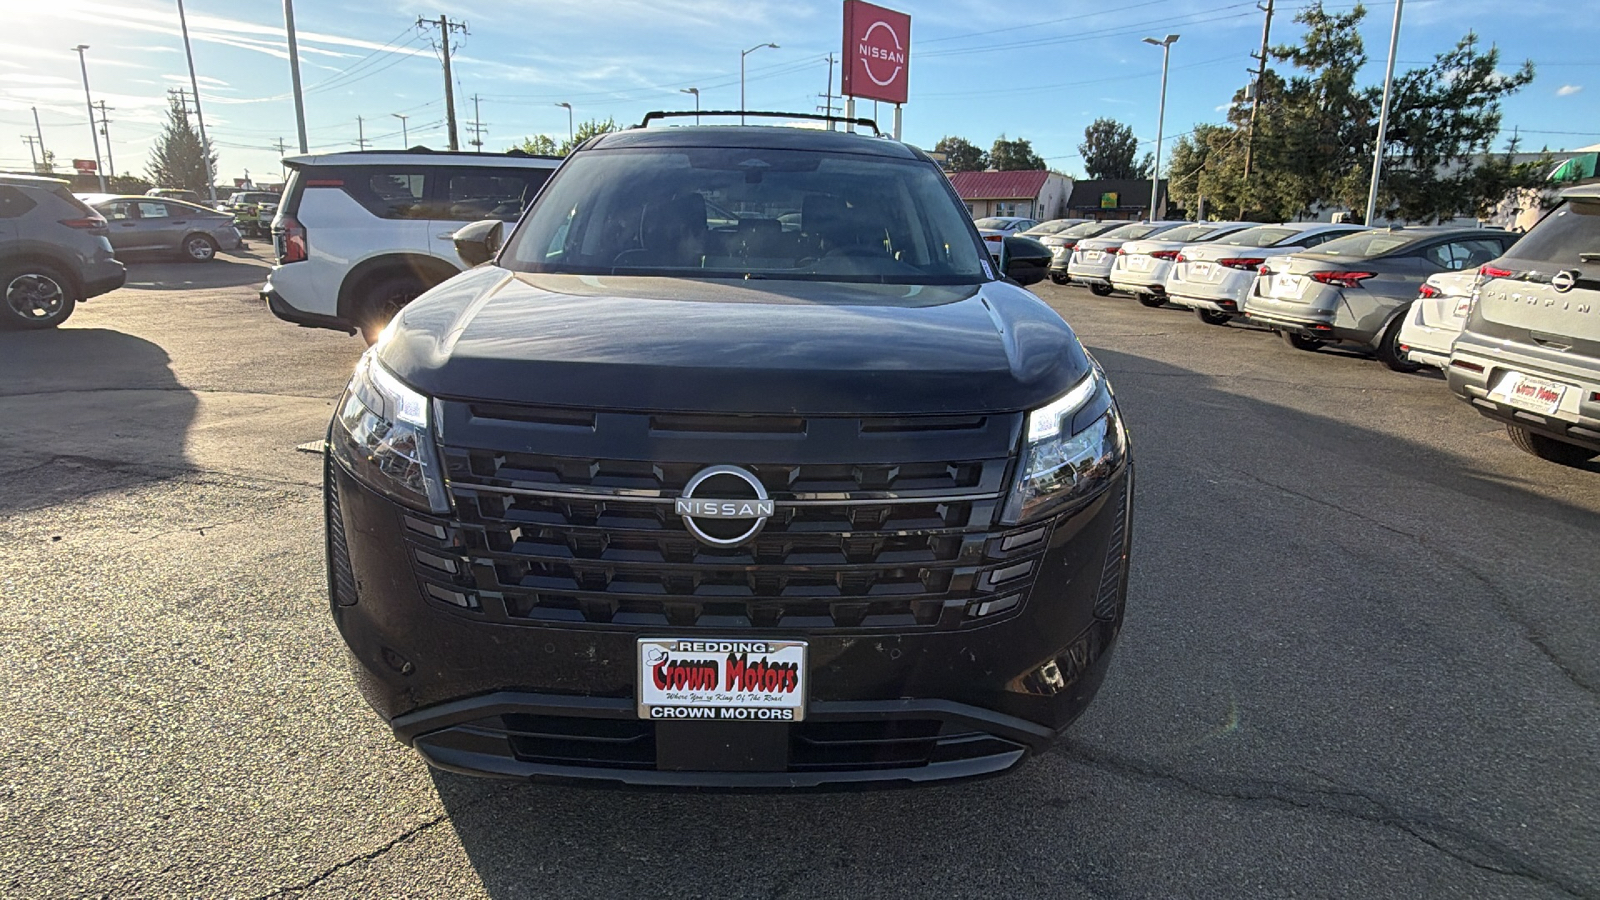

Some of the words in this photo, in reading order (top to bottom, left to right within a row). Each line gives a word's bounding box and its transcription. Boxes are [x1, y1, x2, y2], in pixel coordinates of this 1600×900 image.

[859, 43, 904, 64] NISSAN
[1487, 290, 1600, 315] PATHFIN
[677, 501, 772, 516] NISSAN
[679, 642, 766, 653] REDDING
[653, 652, 719, 691] Crown
[725, 653, 799, 694] Motors
[666, 692, 689, 700] Where
[715, 694, 734, 702] King
[735, 694, 746, 702] Of
[747, 693, 761, 702] The
[763, 694, 783, 702] Road
[651, 706, 716, 719] CROWN
[720, 707, 794, 720] MOTORS
